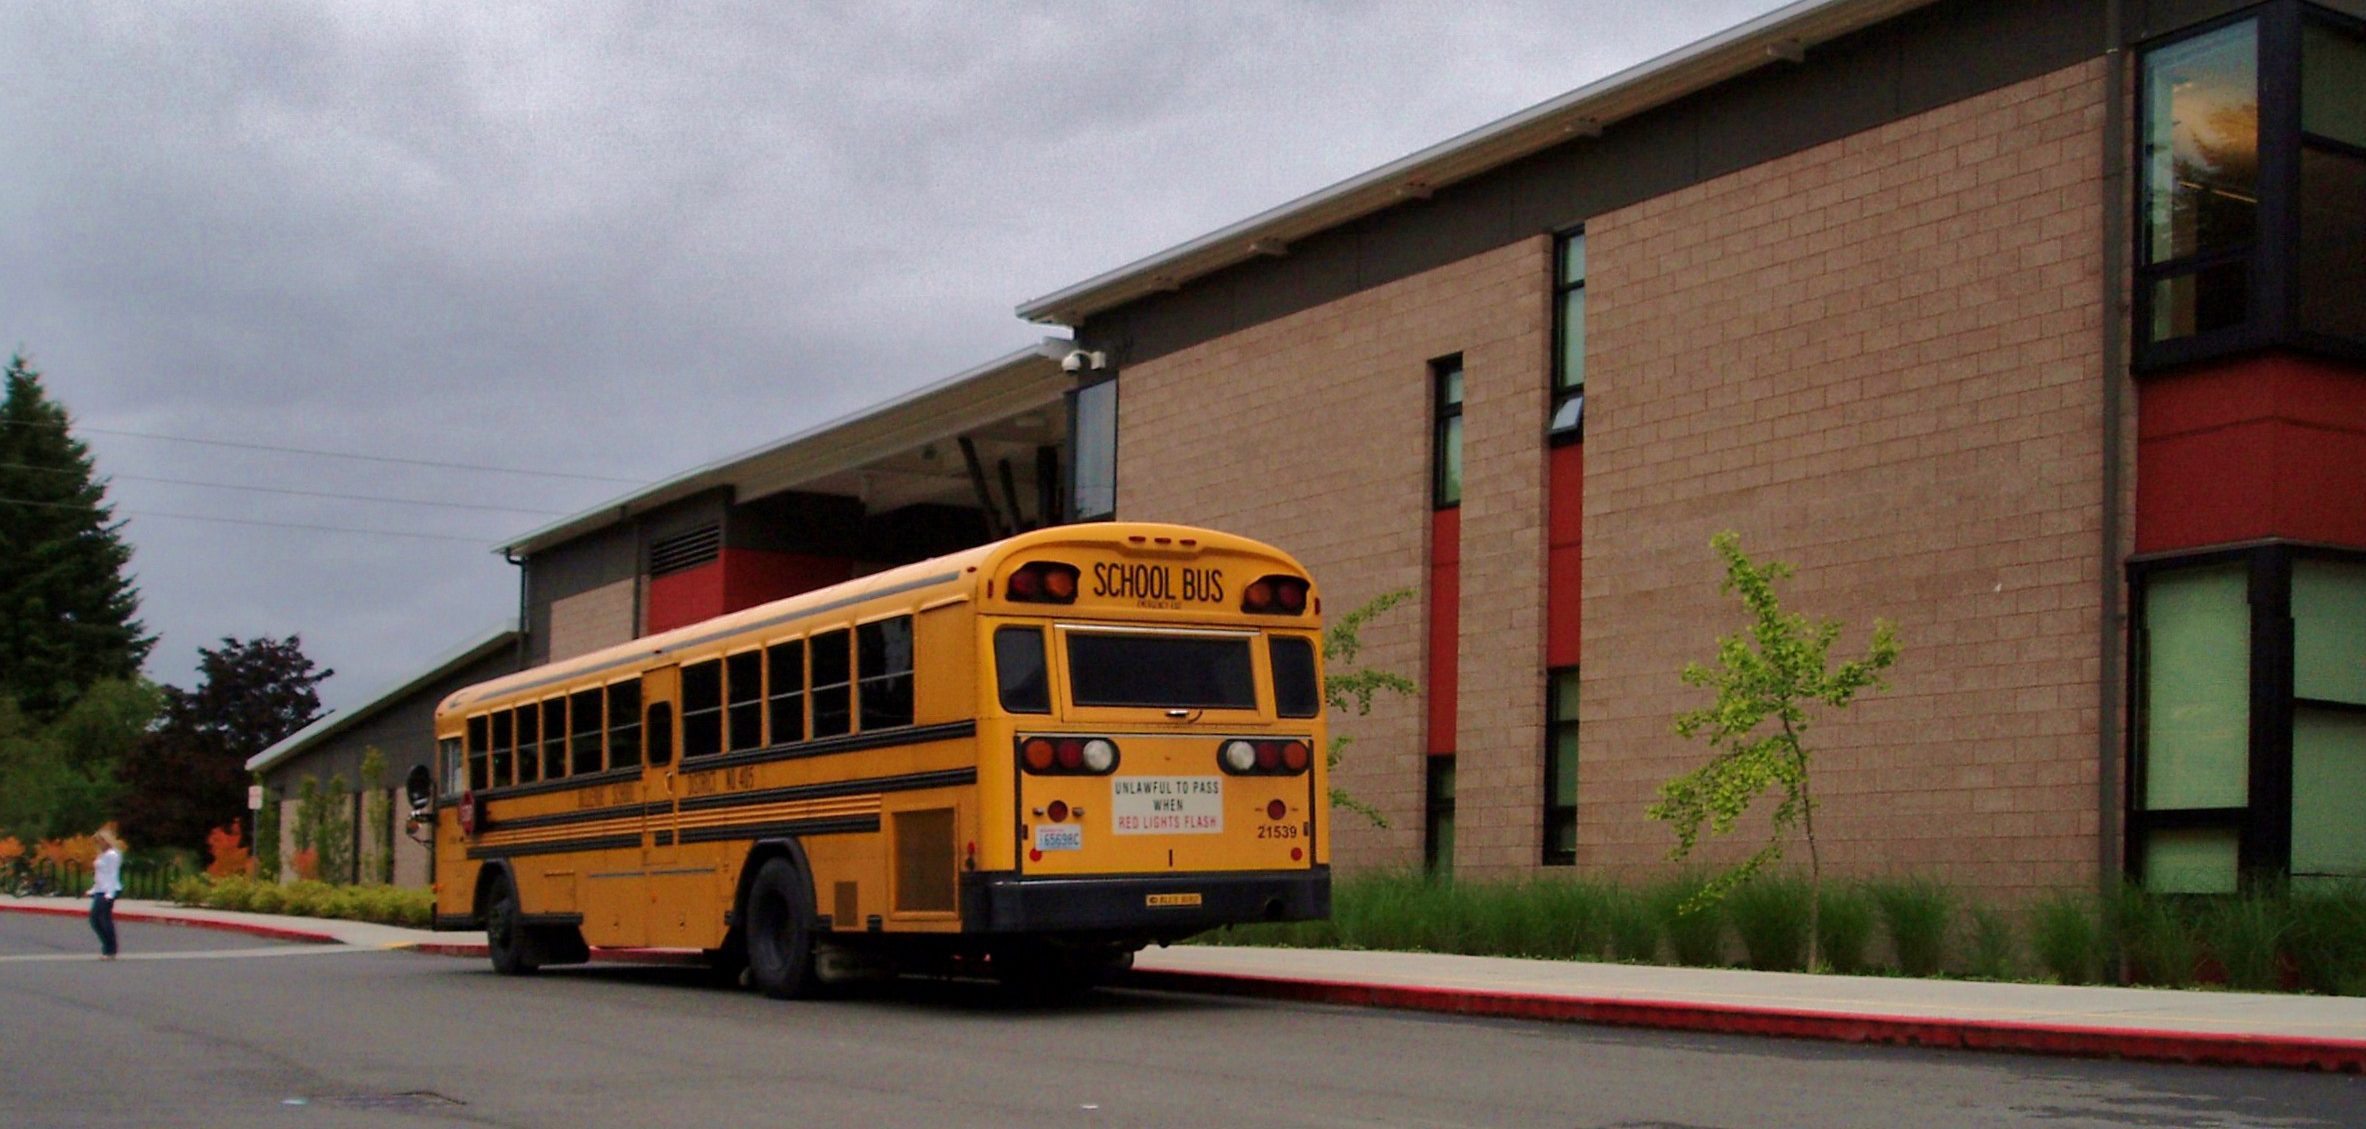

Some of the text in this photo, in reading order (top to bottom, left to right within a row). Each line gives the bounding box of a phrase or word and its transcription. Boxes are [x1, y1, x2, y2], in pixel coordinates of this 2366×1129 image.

[1093, 562, 1224, 603] SCHOOL BUS
[1115, 781, 1219, 795] UNLAWFUL TO PASS
[1153, 799, 1184, 811] WHEN
[1119, 816, 1217, 829] RED LIGHTS FLASH
[1257, 825, 1298, 839] 21539
